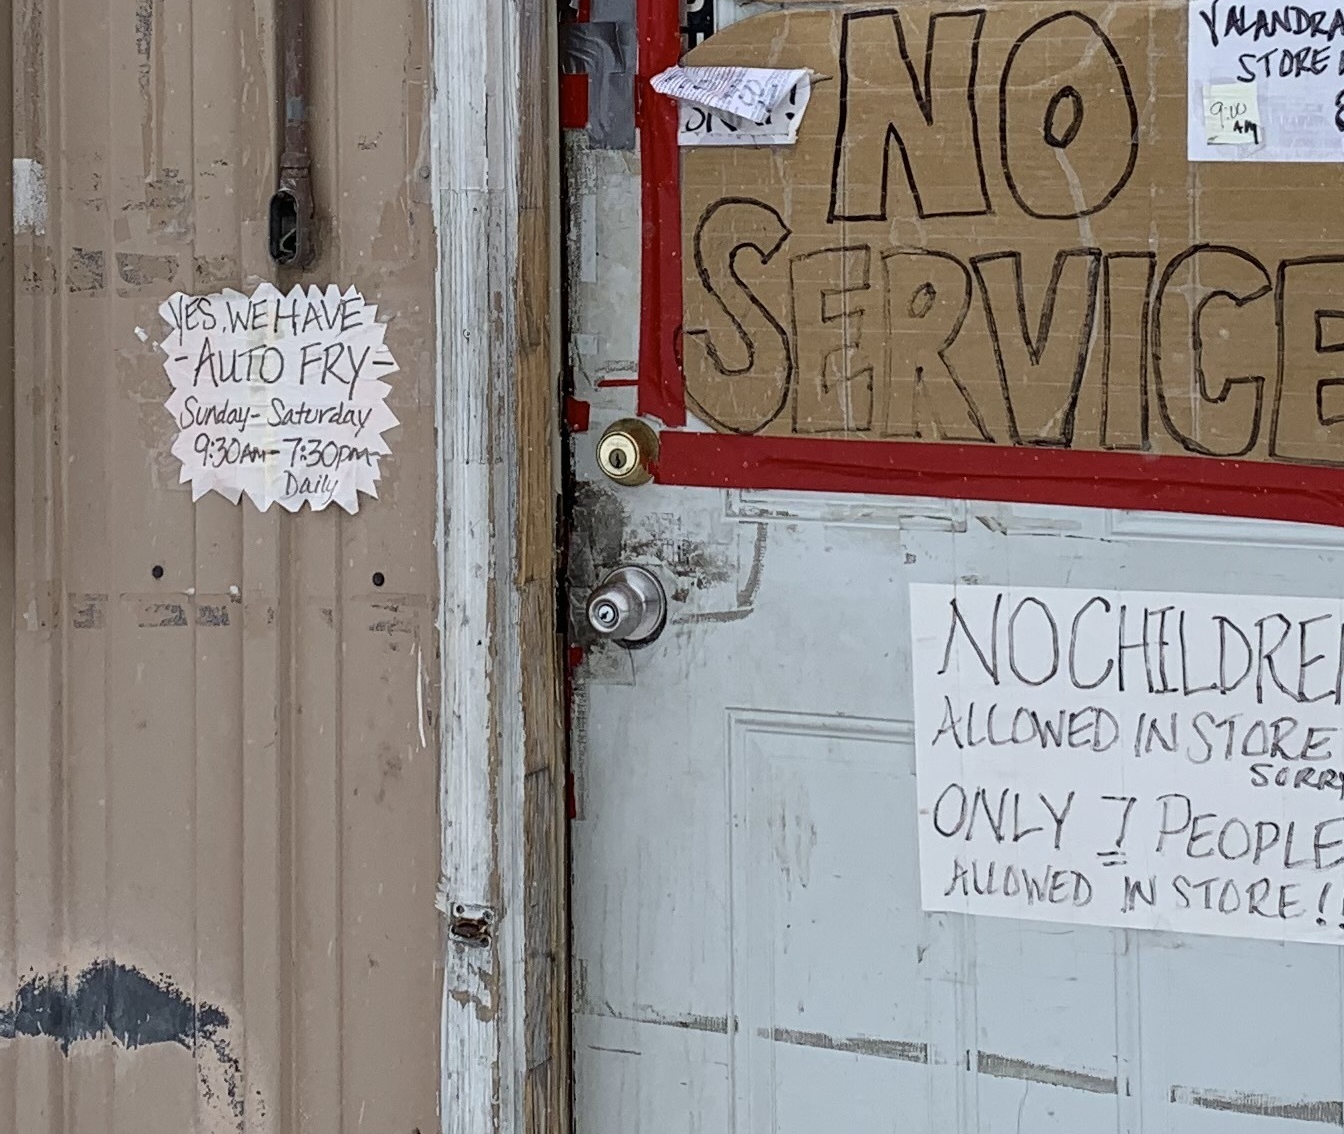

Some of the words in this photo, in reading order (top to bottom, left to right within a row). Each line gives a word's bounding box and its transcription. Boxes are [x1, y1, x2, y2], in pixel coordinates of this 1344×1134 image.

[1237, 46, 1330, 83] STORE
[827, 8, 1140, 224] NO
[226, 299, 268, 334] WE
[274, 297, 363, 338] HAVE
[267, 398, 372, 437] Saturday
[283, 470, 338, 506] Daily
[937, 594, 1059, 687] NO
[932, 695, 1119, 752] ALLOWED
[1134, 712, 1178, 757] IN
[1187, 711, 1342, 764] STORE
[933, 782, 1075, 849] ONLY
[1101, 795, 1138, 850] 7
[944, 859, 1093, 906] ALLOWED
[1121, 875, 1156, 914] IN
